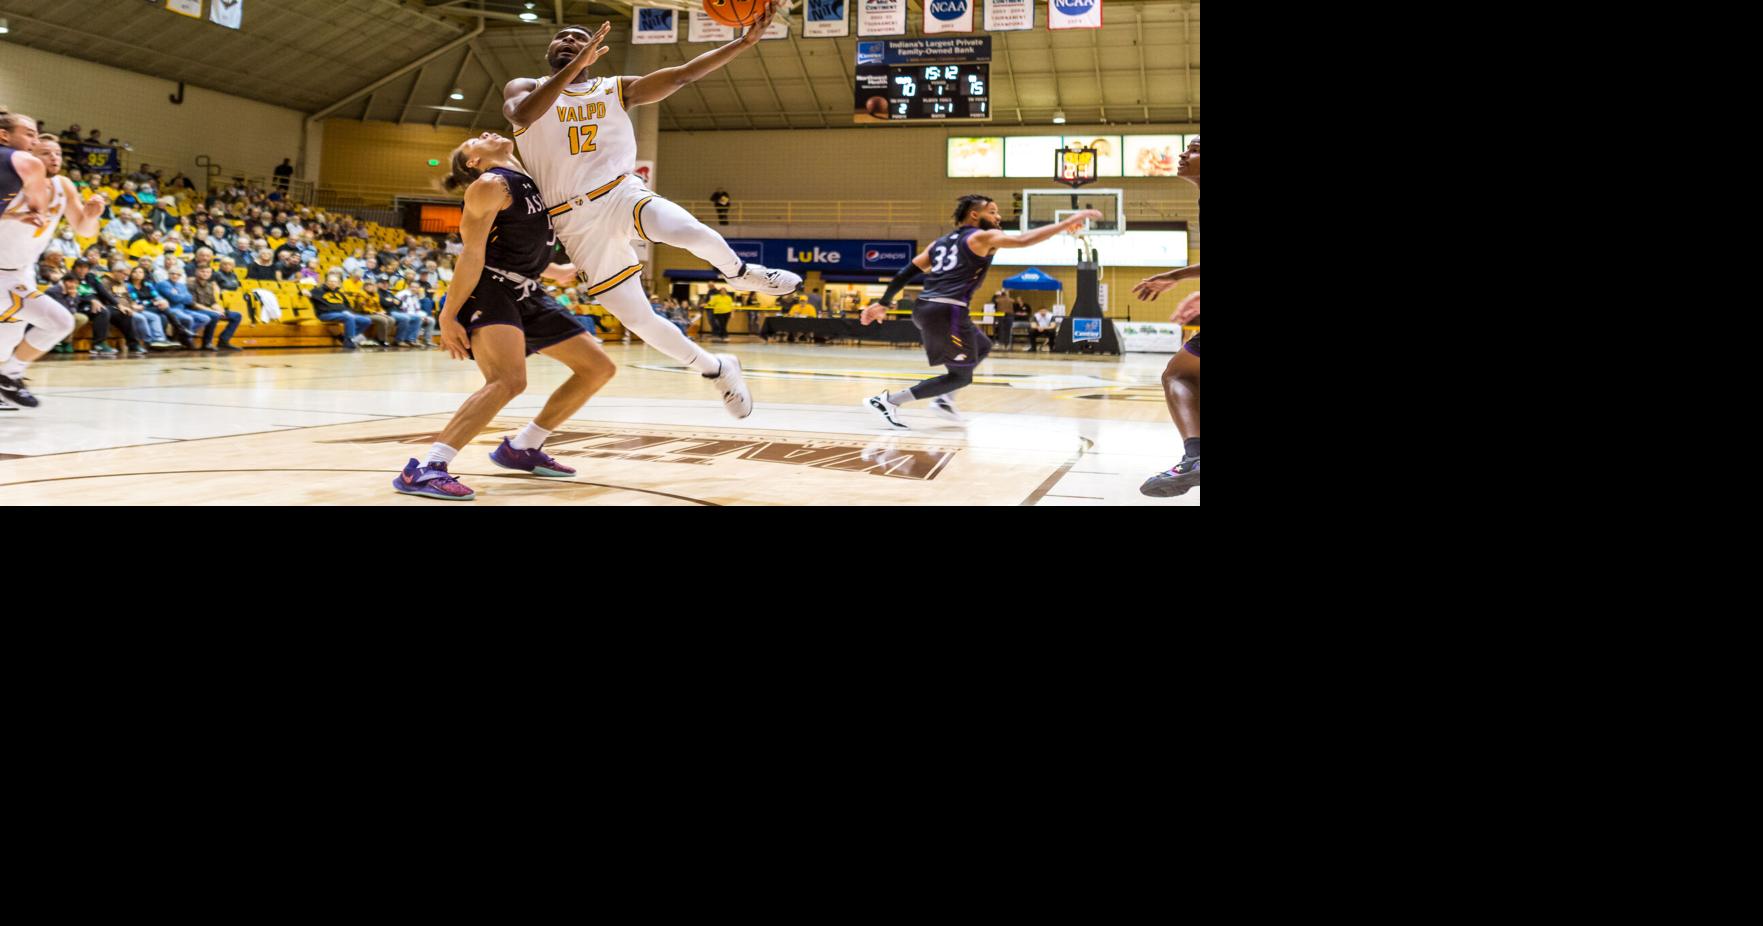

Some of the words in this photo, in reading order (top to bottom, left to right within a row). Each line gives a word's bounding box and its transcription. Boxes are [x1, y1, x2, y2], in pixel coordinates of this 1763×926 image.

[931, 1, 966, 13] NCAA
[1055, 0, 1094, 8] NCAA
[889, 41, 924, 49] Indiana's
[925, 40, 955, 49] Largest
[898, 47, 953, 56] Family-Owned
[954, 46, 974, 54] Bank
[925, 66, 958, 80] 15:12
[970, 81, 984, 95] 15
[556, 102, 606, 122] VALPO
[898, 103, 908, 114] 2
[980, 102, 986, 112] 1
[568, 124, 598, 155] 12
[787, 247, 841, 263] Luke
[879, 252, 906, 260] pepsi
[931, 244, 959, 272] 33
